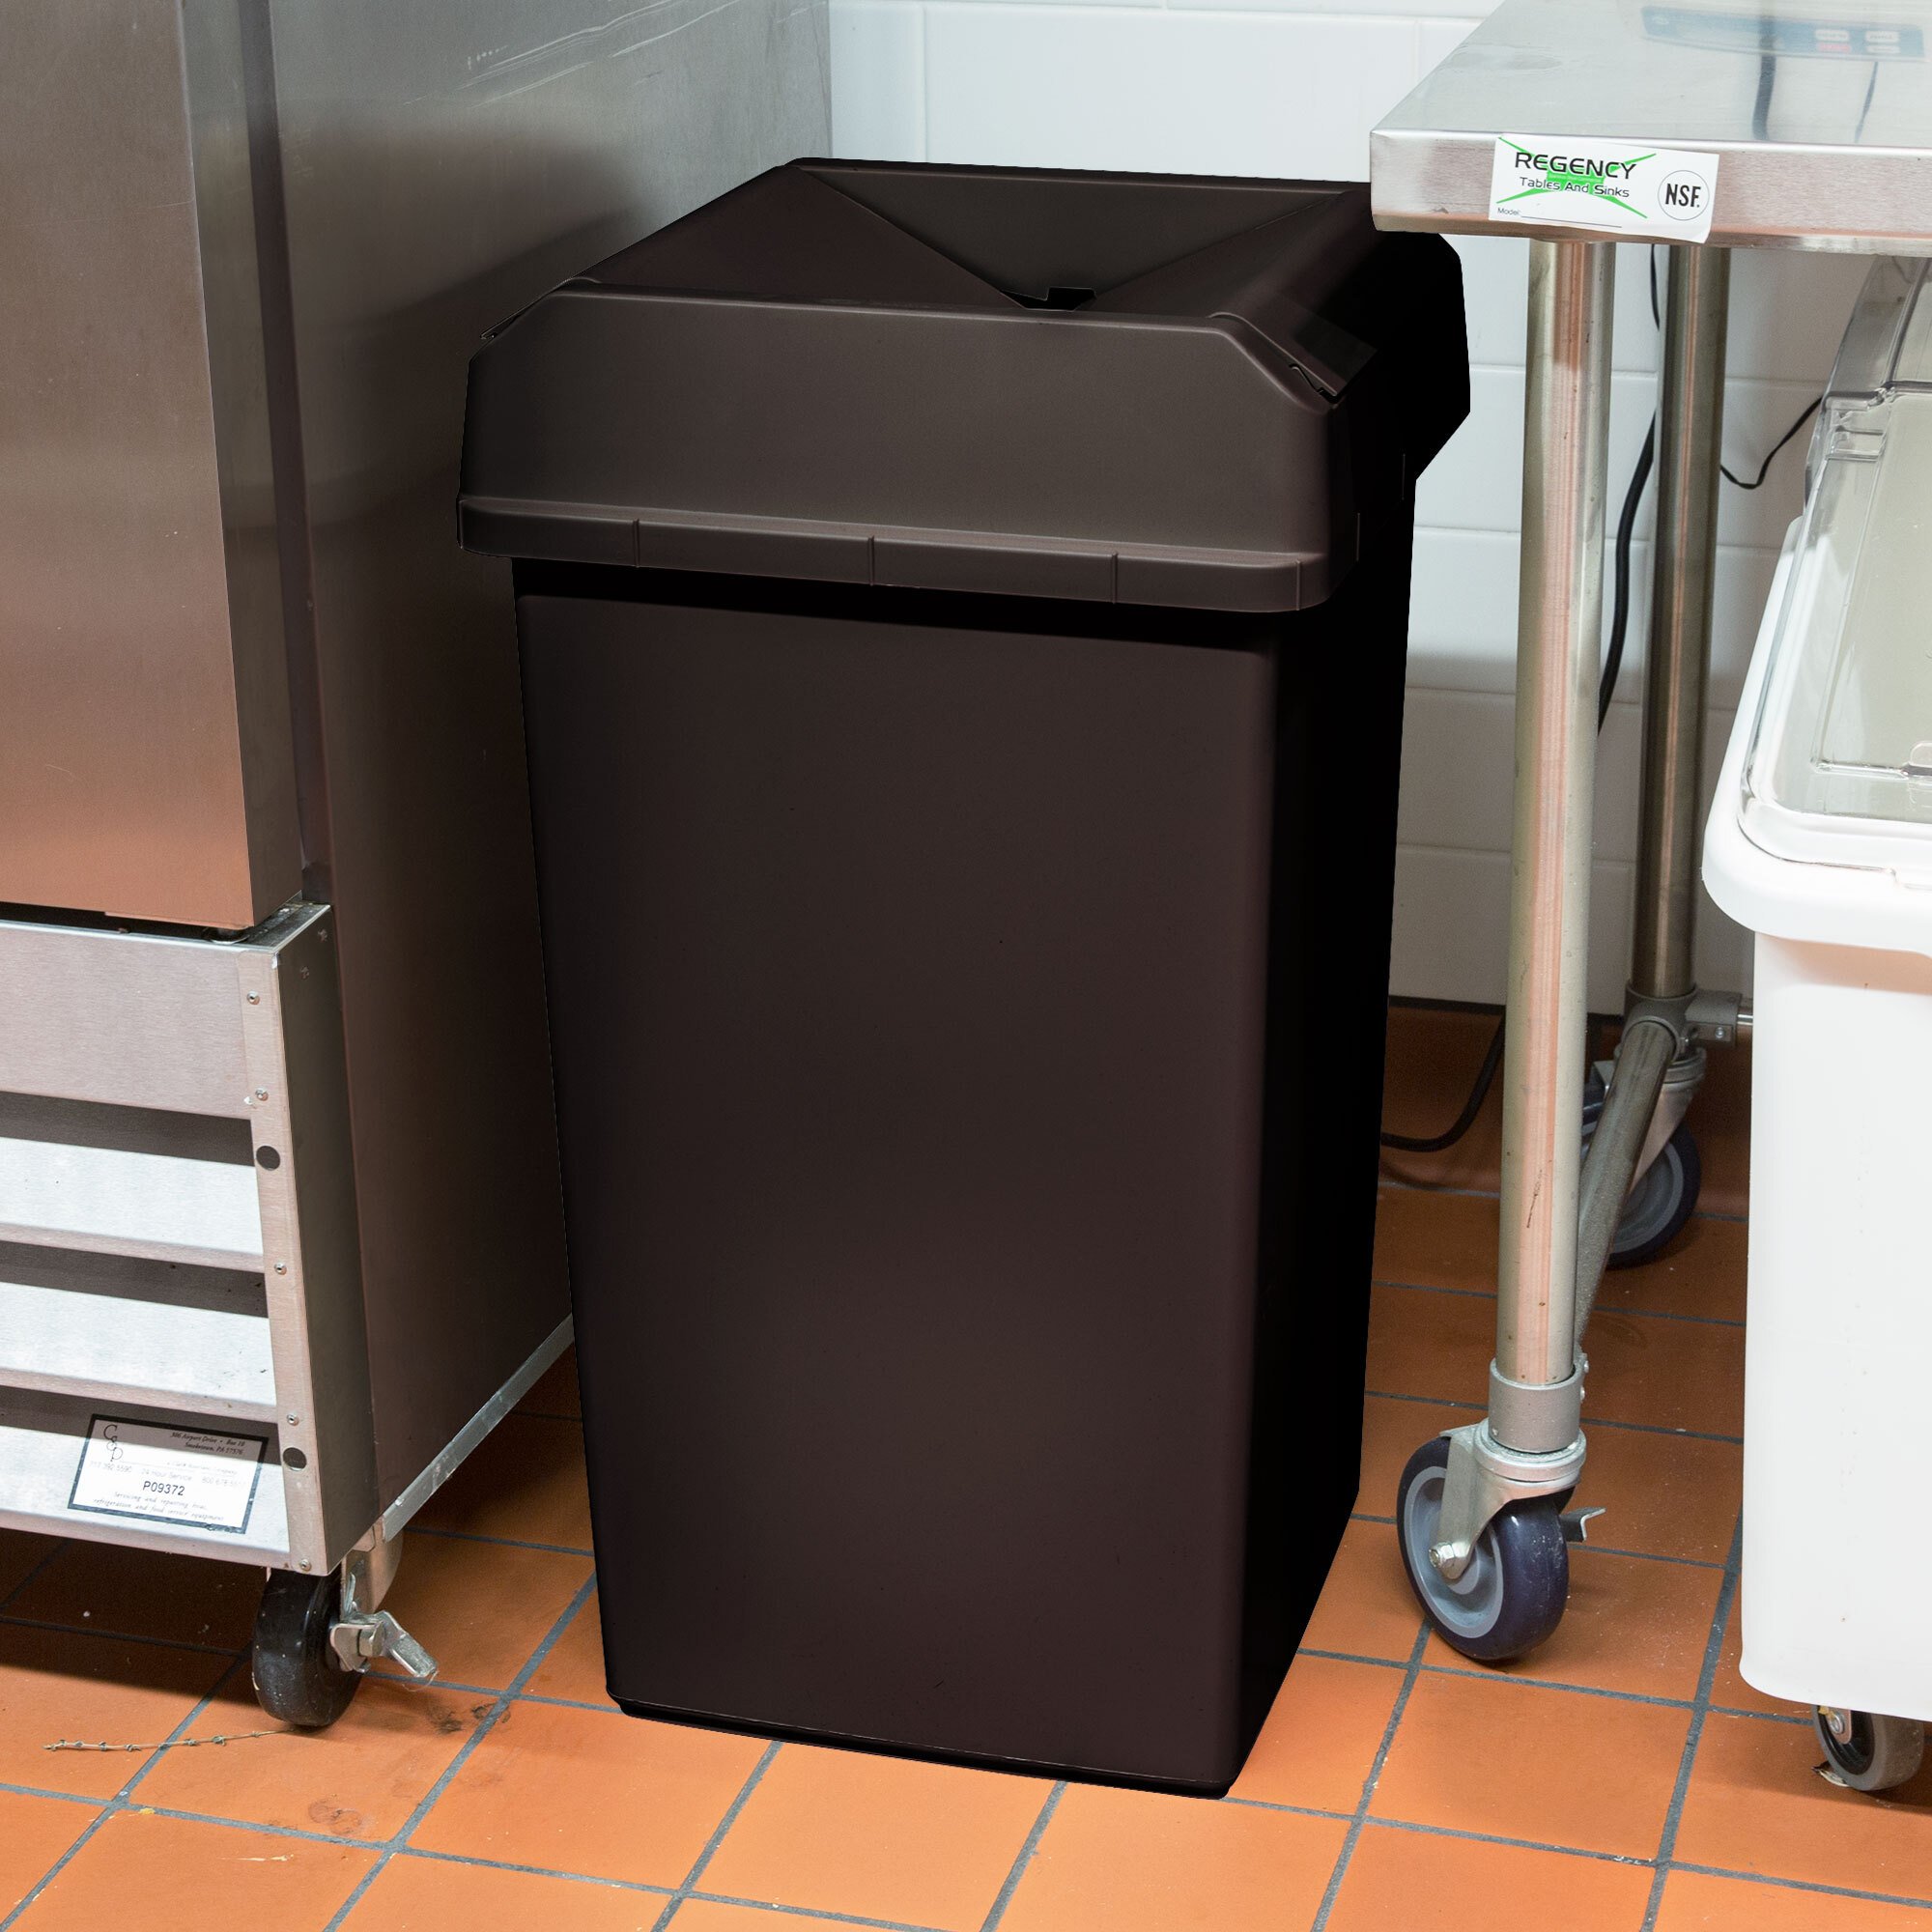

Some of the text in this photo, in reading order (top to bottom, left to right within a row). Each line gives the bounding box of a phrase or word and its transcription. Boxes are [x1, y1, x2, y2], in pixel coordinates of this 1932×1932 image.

[1515, 152, 1636, 180] REGENCY
[1520, 177, 1560, 190] Tables
[1564, 182, 1589, 193] And
[1594, 185, 1630, 198] Sinks
[142, 1480, 185, 1496] P09372
